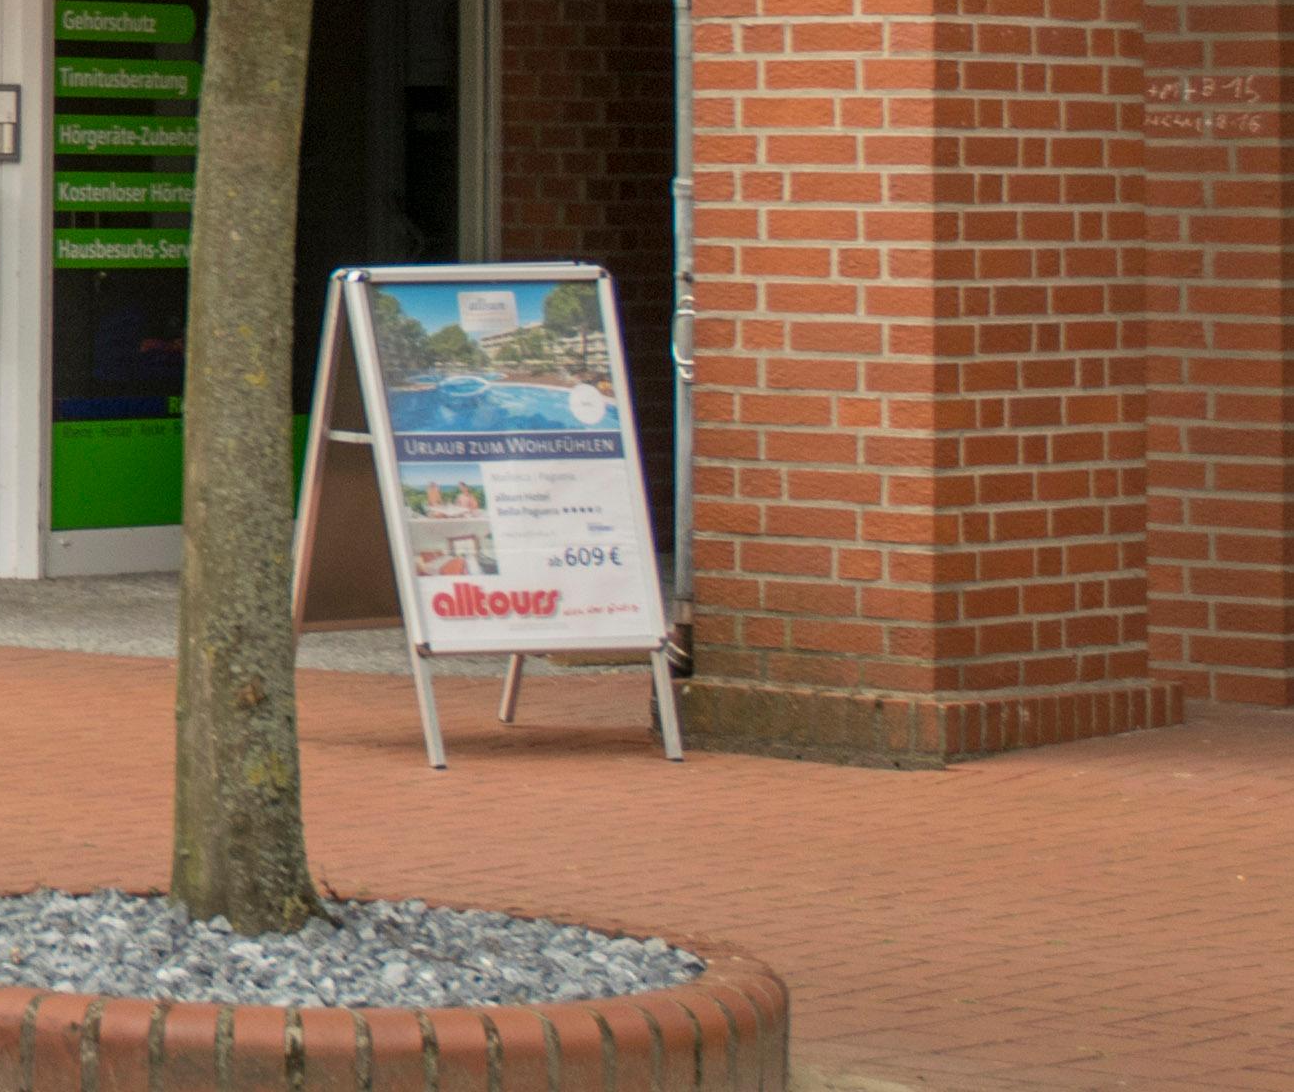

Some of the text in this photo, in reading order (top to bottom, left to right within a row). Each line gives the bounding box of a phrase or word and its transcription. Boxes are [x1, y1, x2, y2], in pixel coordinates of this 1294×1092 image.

[62, 9, 157, 35] Gehörschutz
[59, 65, 188, 96] Tinnitusberatung
[57, 181, 196, 204] Kostenloser Hörte
[403, 436, 615, 456] URLAUB ZUM WOHLFÜHLEN
[564, 546, 605, 567] 609
[609, 546, 623, 567] €
[431, 581, 561, 619] alltours
